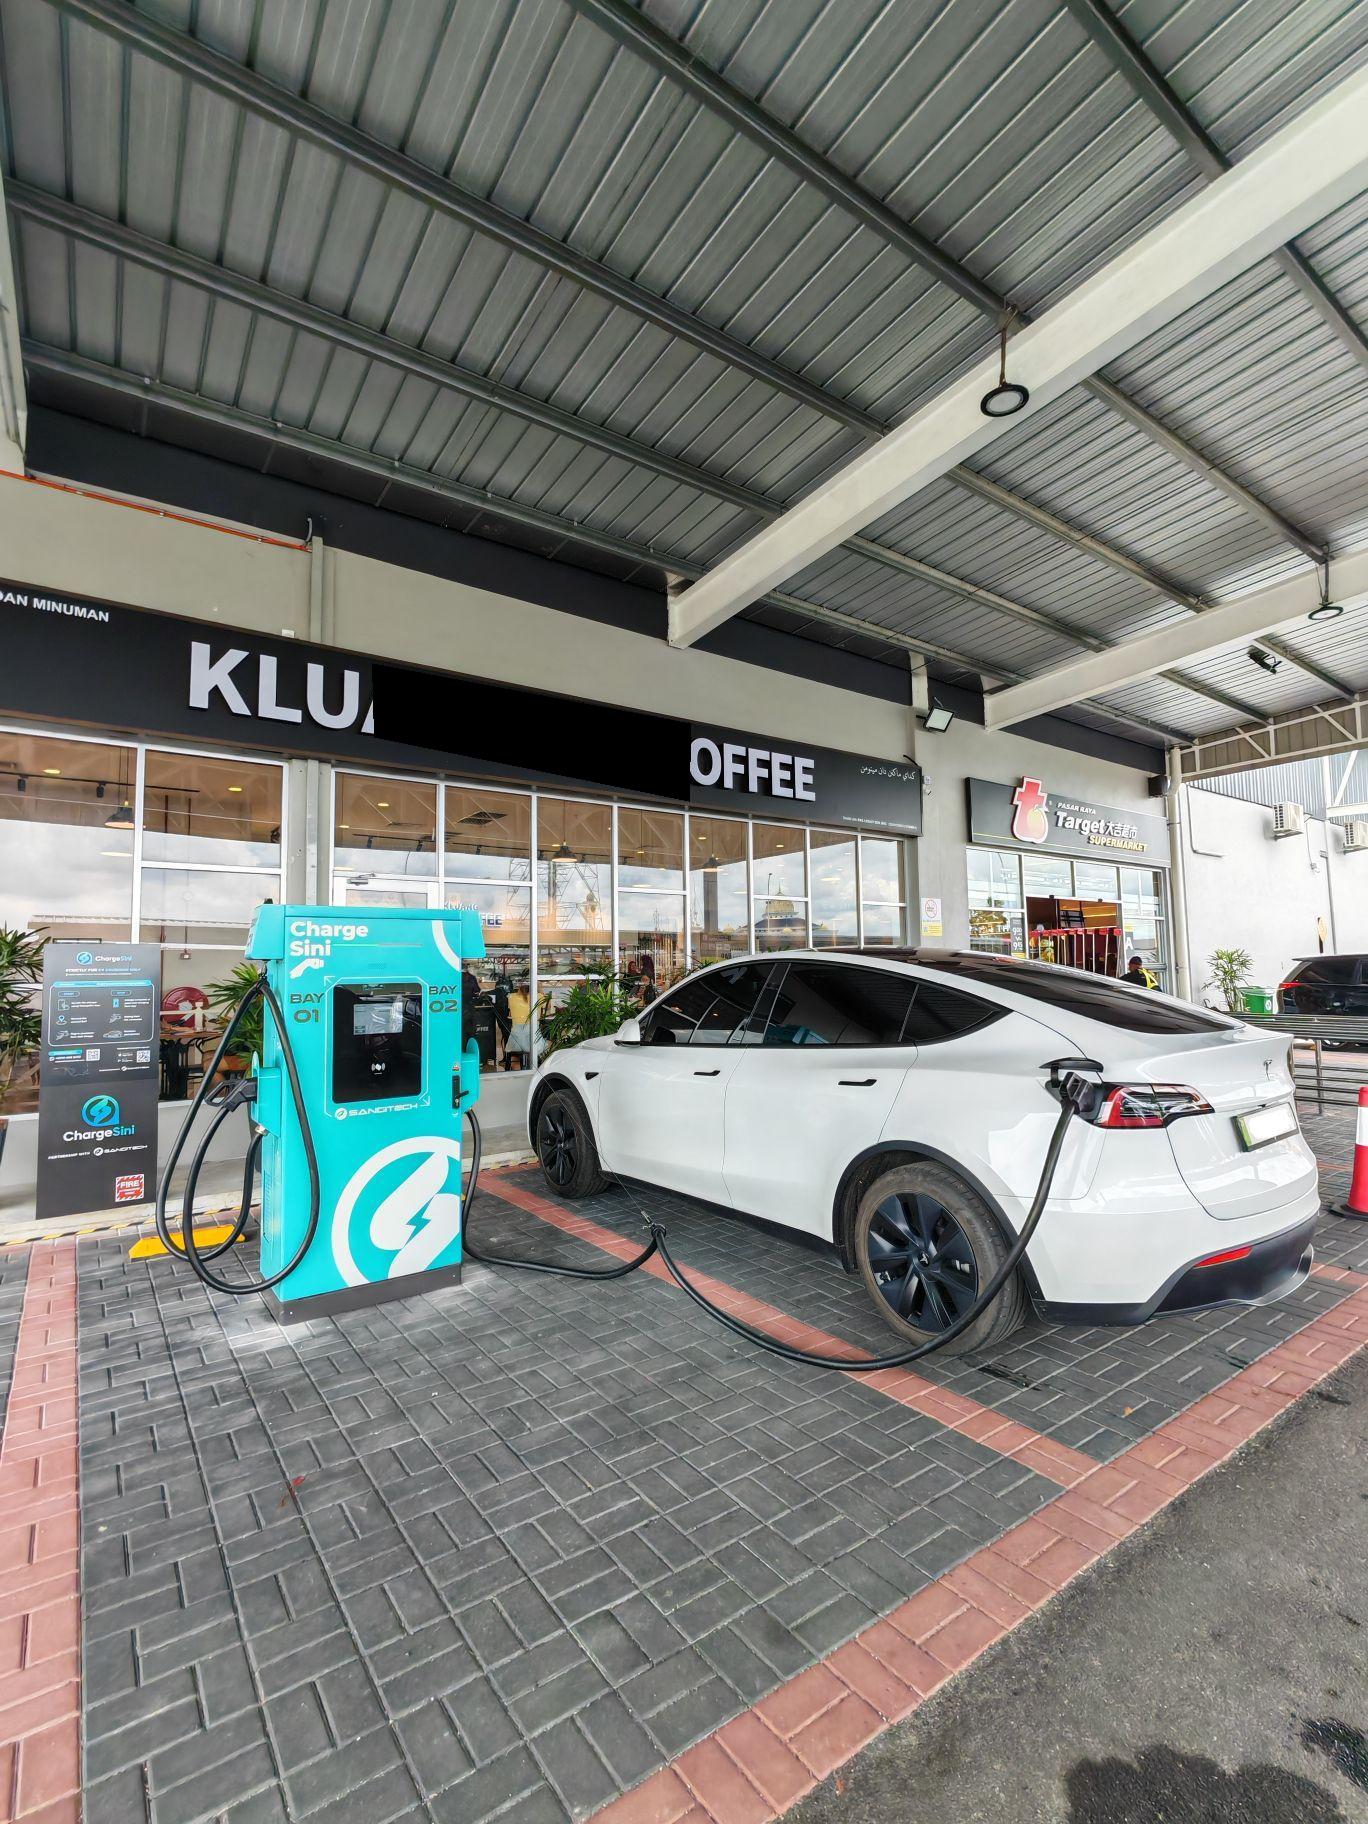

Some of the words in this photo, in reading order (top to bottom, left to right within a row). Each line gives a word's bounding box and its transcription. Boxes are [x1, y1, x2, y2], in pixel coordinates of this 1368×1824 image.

[33, 597, 109, 622] MINUMAN
[189, 641, 375, 734] KLU
[1057, 802, 1080, 812] PASAR
[1080, 806, 1096, 815] RAYA
[1056, 810, 1106, 836] Target
[1089, 835, 1148, 852] SUPERMARKET
[290, 921, 369, 941] Charge
[289, 939, 331, 957] Sini
[290, 993, 325, 1004] BAY
[429, 985, 458, 995] BAY
[429, 1000, 458, 1013] 02
[293, 1009, 319, 1023] 01
[63, 1125, 135, 1142] ChargeSini
[120, 1180, 140, 1188] FIRE
